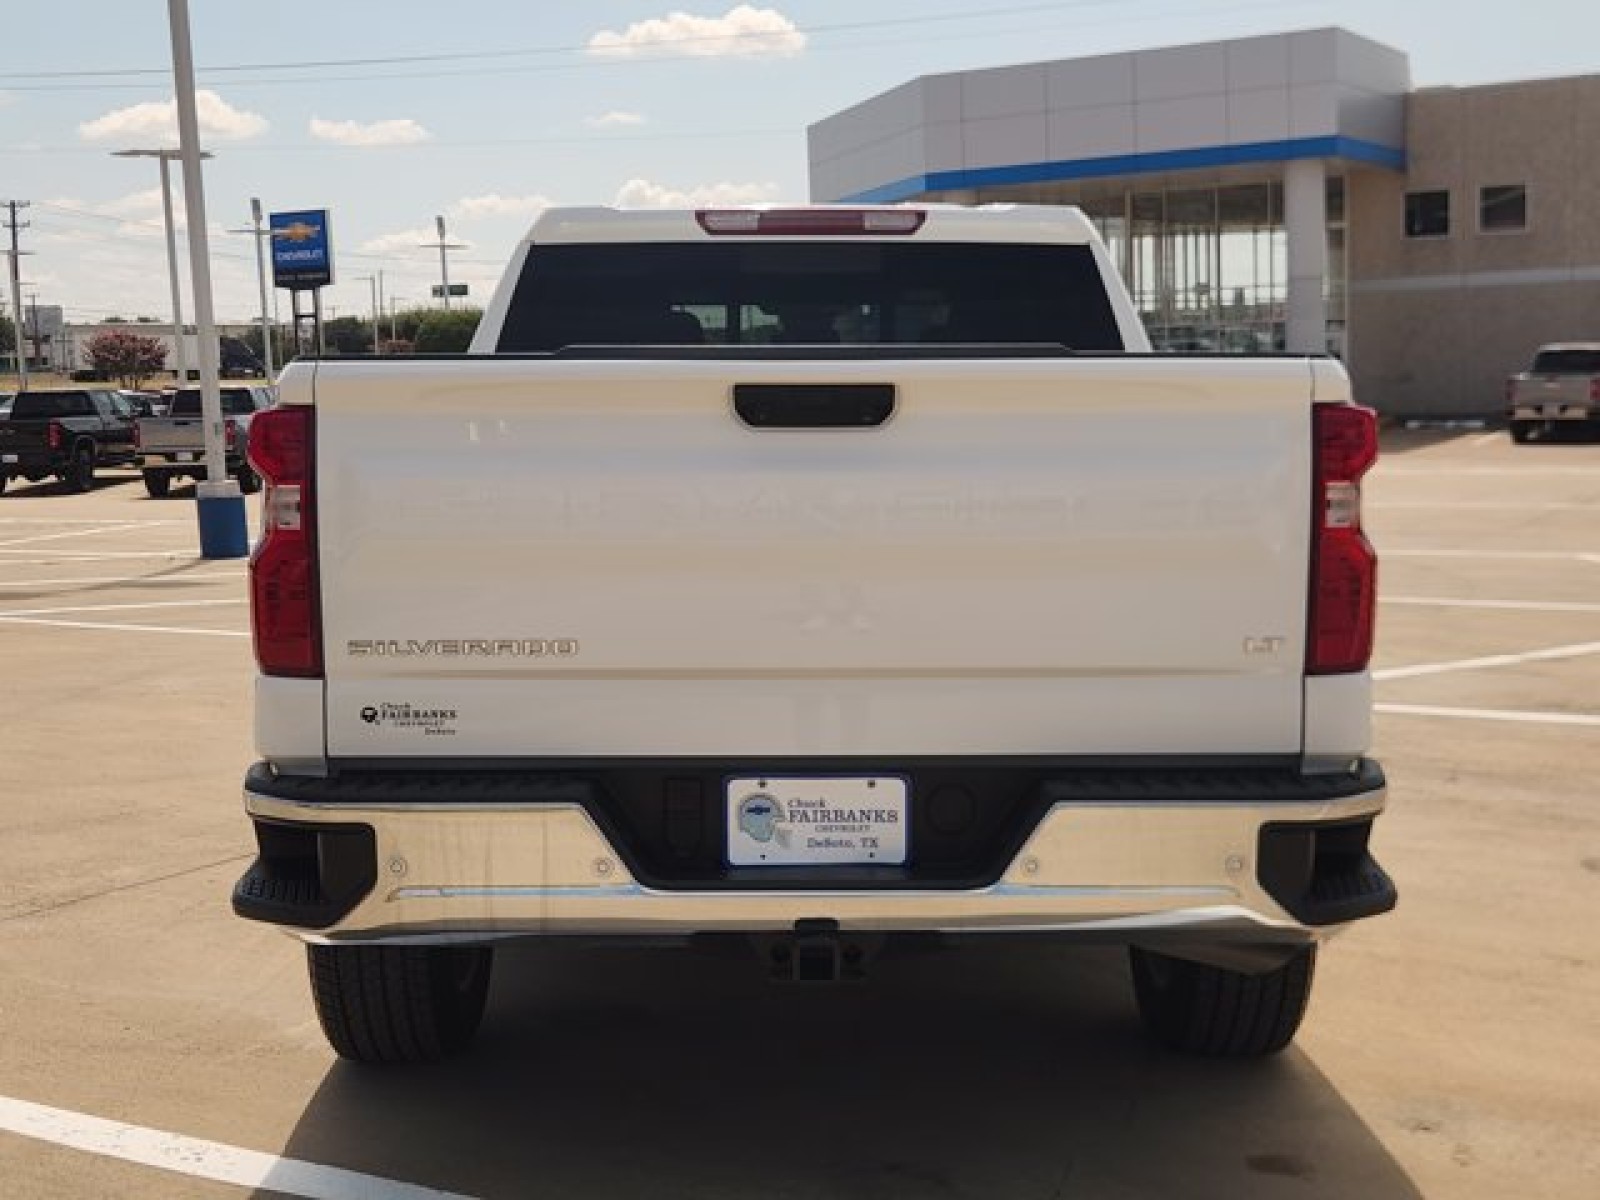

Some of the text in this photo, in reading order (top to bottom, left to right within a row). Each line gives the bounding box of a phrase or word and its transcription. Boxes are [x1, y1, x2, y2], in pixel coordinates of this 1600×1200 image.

[347, 639, 579, 656] SILVERADO
[1242, 635, 1287, 655] LT
[381, 709, 458, 720] FAIRBANKS
[787, 796, 826, 809] Chuck
[788, 809, 899, 824] FAIRBANKS
[859, 837, 879, 849] TX
